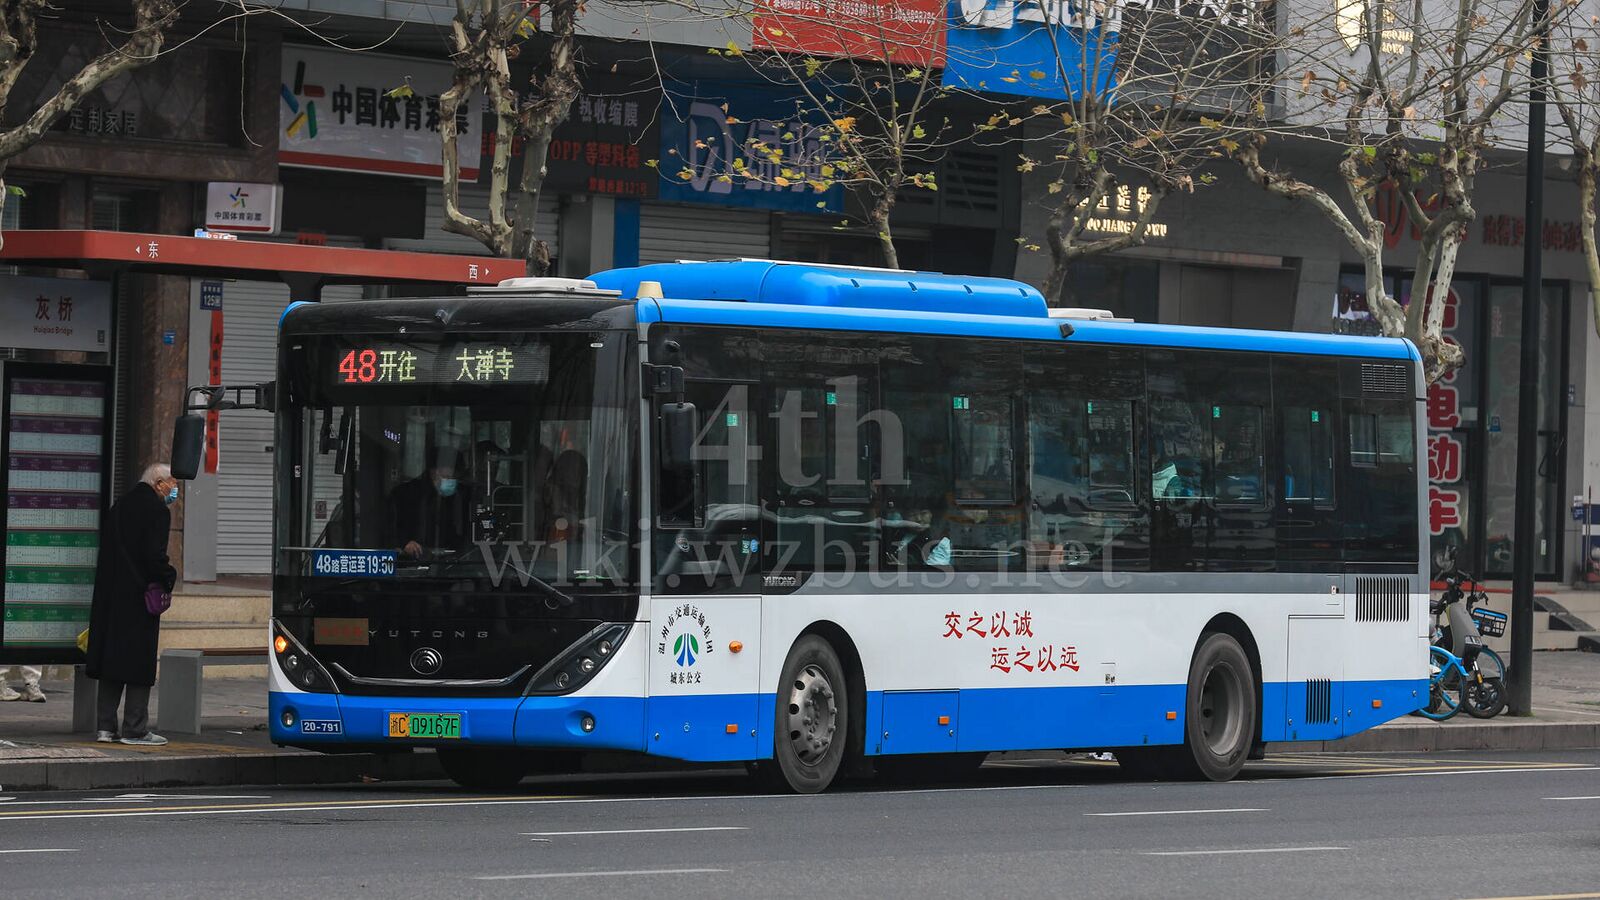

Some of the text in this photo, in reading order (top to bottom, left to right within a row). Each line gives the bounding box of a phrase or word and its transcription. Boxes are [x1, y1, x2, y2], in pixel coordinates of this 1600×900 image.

[214, 211, 262, 221] 中国体育彩票
[148, 241, 158, 258] 东
[469, 265, 478, 279] 西
[35, 294, 73, 321] 灰桥
[339, 348, 514, 382] 48 开往 大禅寺
[316, 554, 394, 575] 48路营运至19:50
[763, 576, 797, 586] YUTONG
[658, 603, 714, 655] 温州市交通运输集团
[943, 610, 1034, 639] 交之以诚
[367, 630, 489, 638] YUTONG
[990, 645, 1080, 674] 运之以远
[670, 671, 701, 685] 城东公交
[303, 721, 340, 732] 20-791
[412, 717, 459, 735] 09167F
